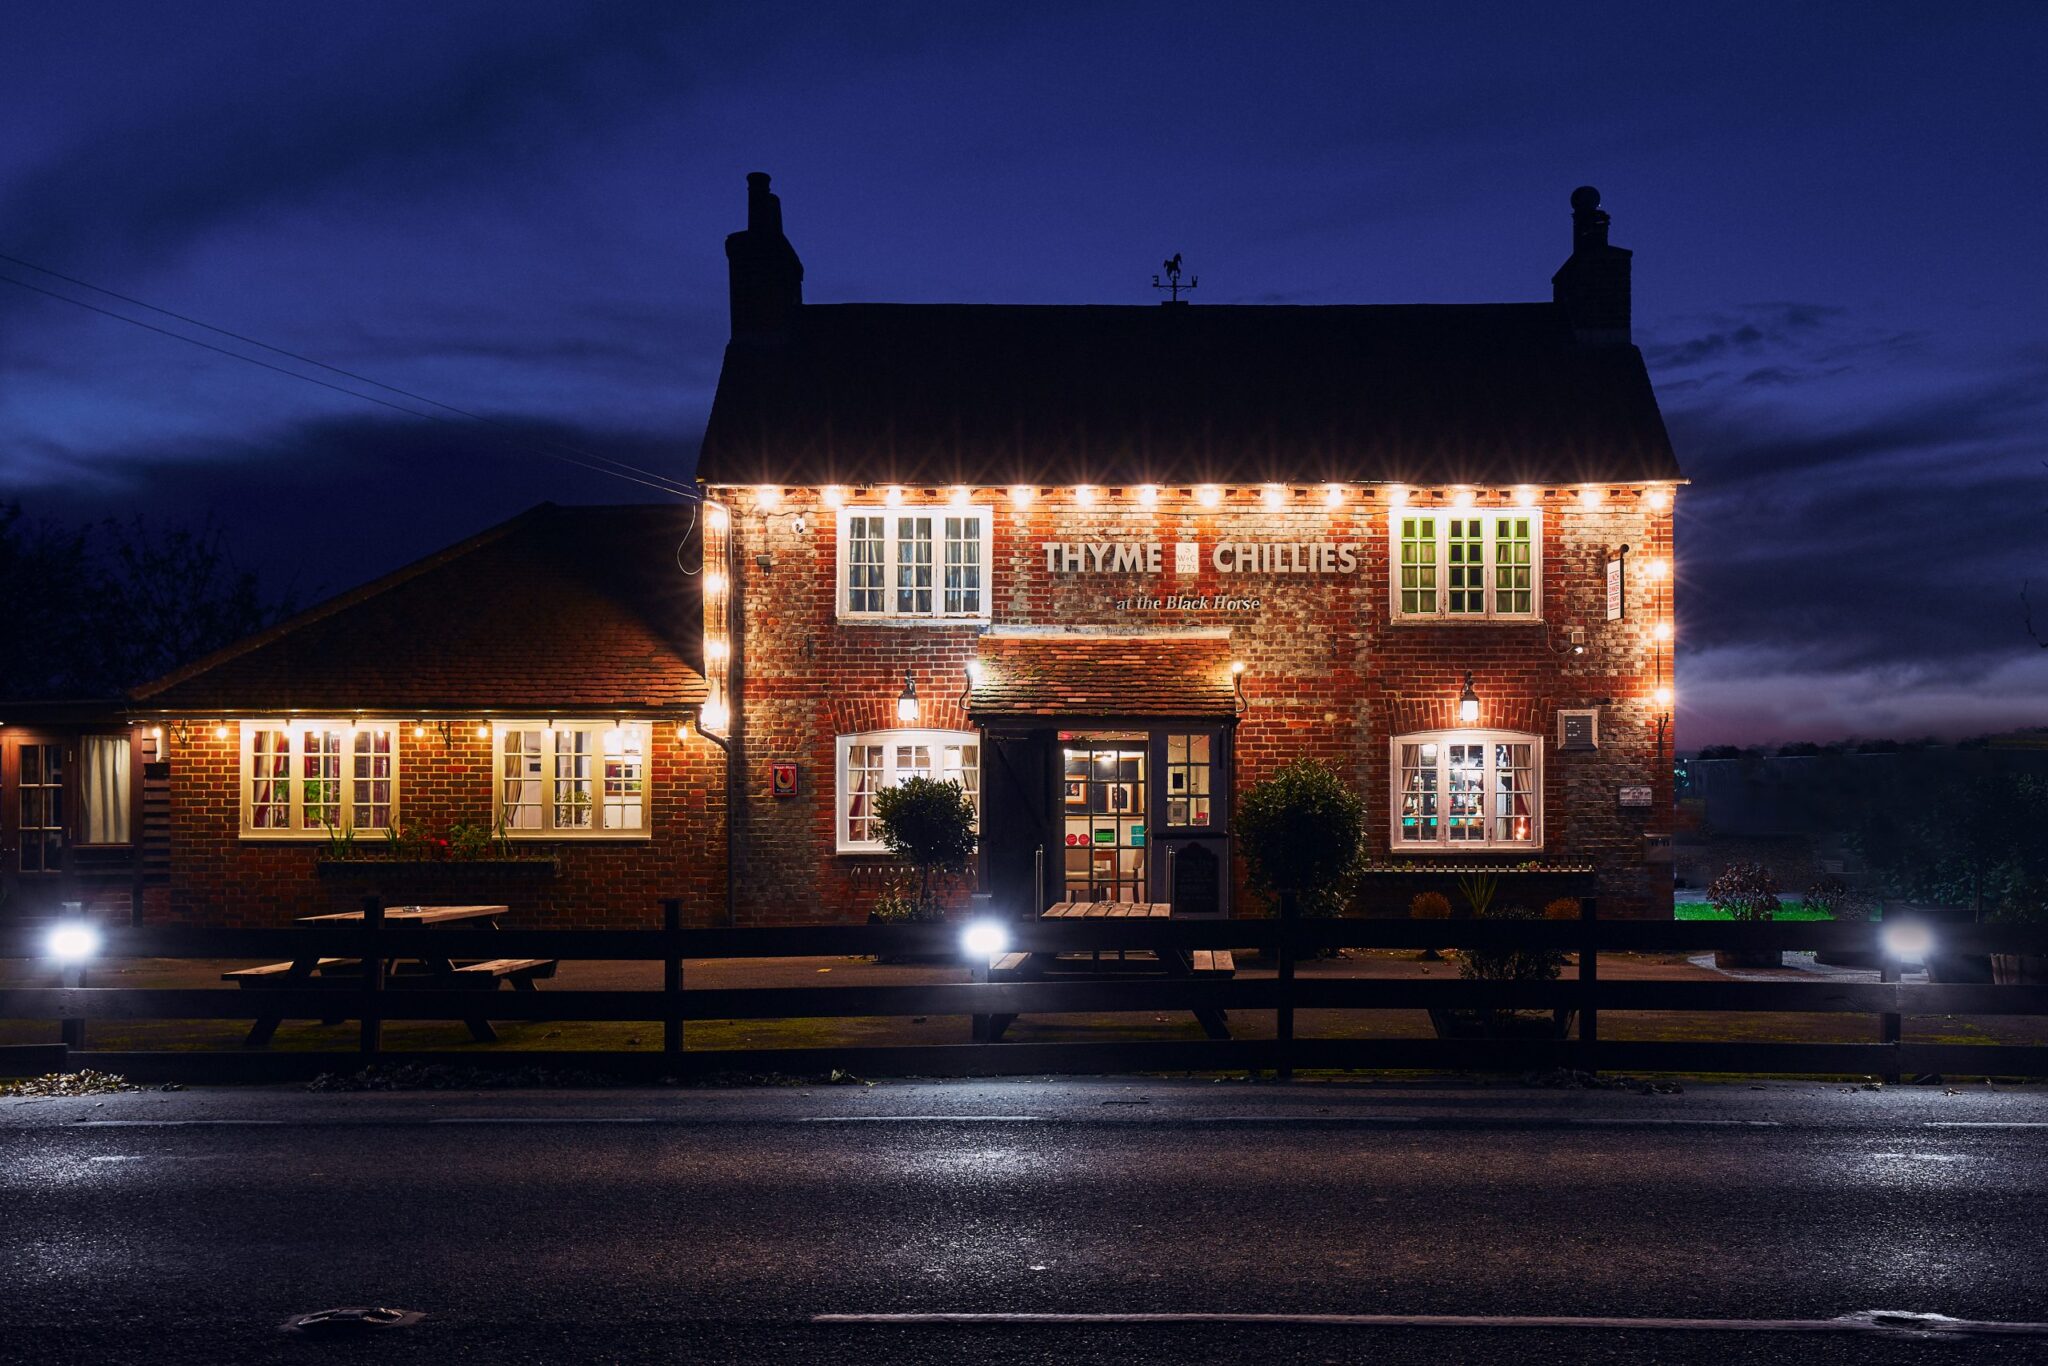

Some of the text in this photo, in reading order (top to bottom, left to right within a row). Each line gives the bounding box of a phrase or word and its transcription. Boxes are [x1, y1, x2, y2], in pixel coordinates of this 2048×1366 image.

[1042, 541, 1358, 574] THYME CHILLIES
[1116, 595, 1261, 611] at the Black Horse
